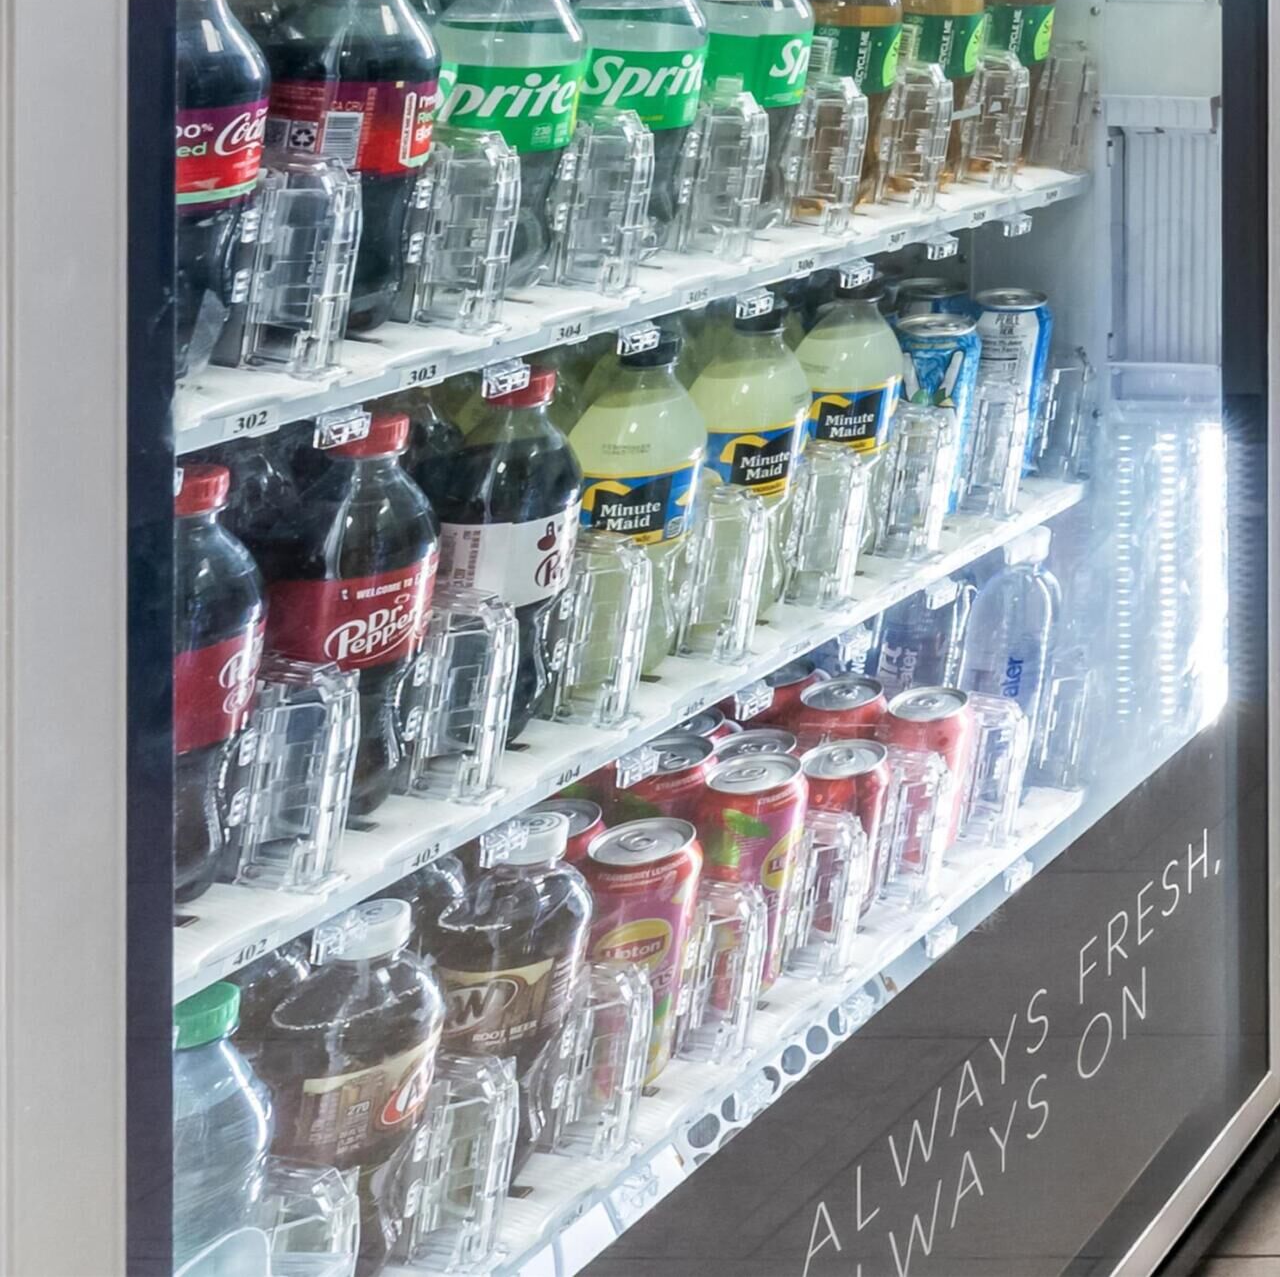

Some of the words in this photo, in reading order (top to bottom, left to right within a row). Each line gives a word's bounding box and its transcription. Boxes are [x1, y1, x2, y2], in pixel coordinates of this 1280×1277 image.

[581, 55, 704, 107] Sprit
[434, 68, 577, 124] Sprite
[686, 289, 708, 306] 305
[556, 323, 582, 340] 304
[407, 365, 437, 383] 303
[233, 411, 268, 433] 302
[825, 411, 875, 428] Minute
[829, 423, 866, 439] Maid
[740, 449, 790, 471] Minute
[745, 462, 783, 481] Maid
[601, 500, 661, 518] Minute
[606, 513, 651, 532] Maid
[356, 581, 402, 600] WELCOME
[368, 605, 404, 635] Dr
[324, 608, 418, 660] Pepper
[1002, 656, 1024, 699] ater
[555, 765, 581, 787] 404
[411, 842, 441, 867] 403
[232, 937, 268, 967] 402
[472, 1028, 506, 1043] ROOT
[508, 1020, 537, 1035] BEER
[803, 988, 1049, 1277] ALWAYS
[1079, 828, 1222, 1005] FRESH,
[888, 1073, 1049, 1277] WAYS
[1076, 965, 1147, 1080] ON
